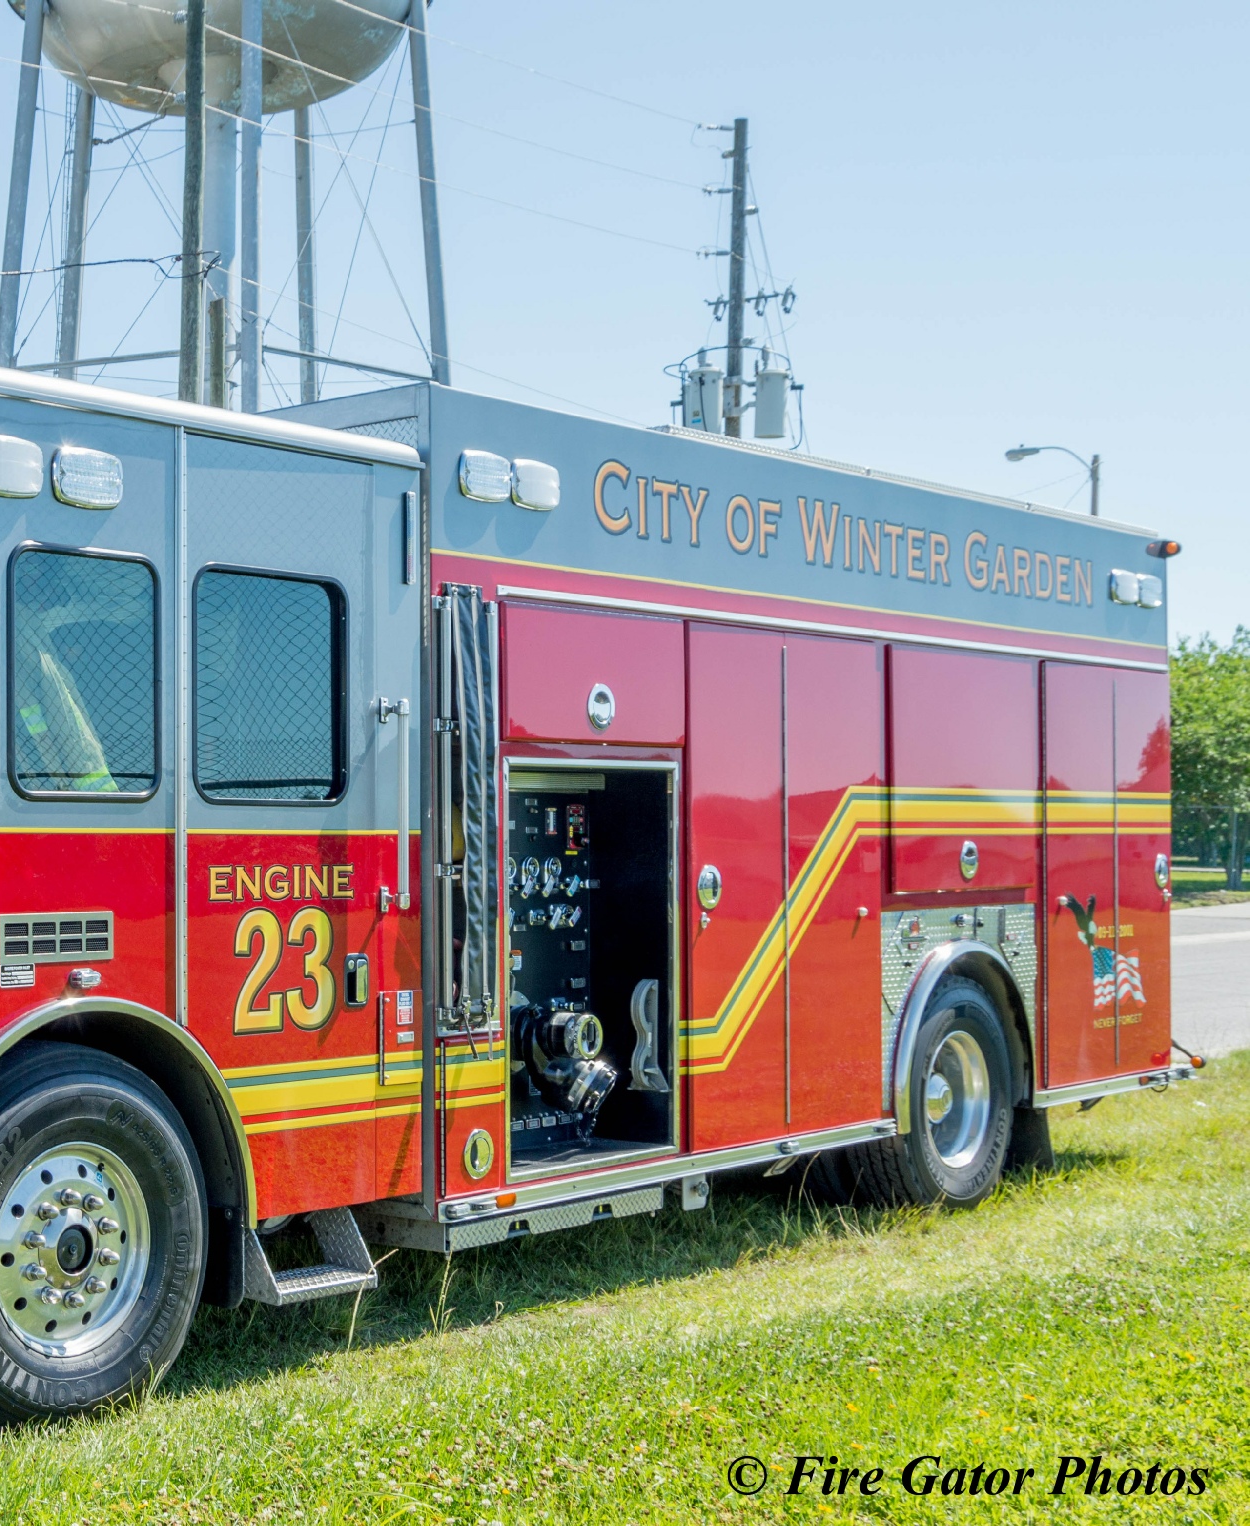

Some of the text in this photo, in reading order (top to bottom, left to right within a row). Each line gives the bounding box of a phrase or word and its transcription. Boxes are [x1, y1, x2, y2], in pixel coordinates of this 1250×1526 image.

[593, 459, 1094, 608] CITY OF WINTER GARDEN
[208, 864, 355, 902] ENGINE
[233, 905, 337, 1037] 23
